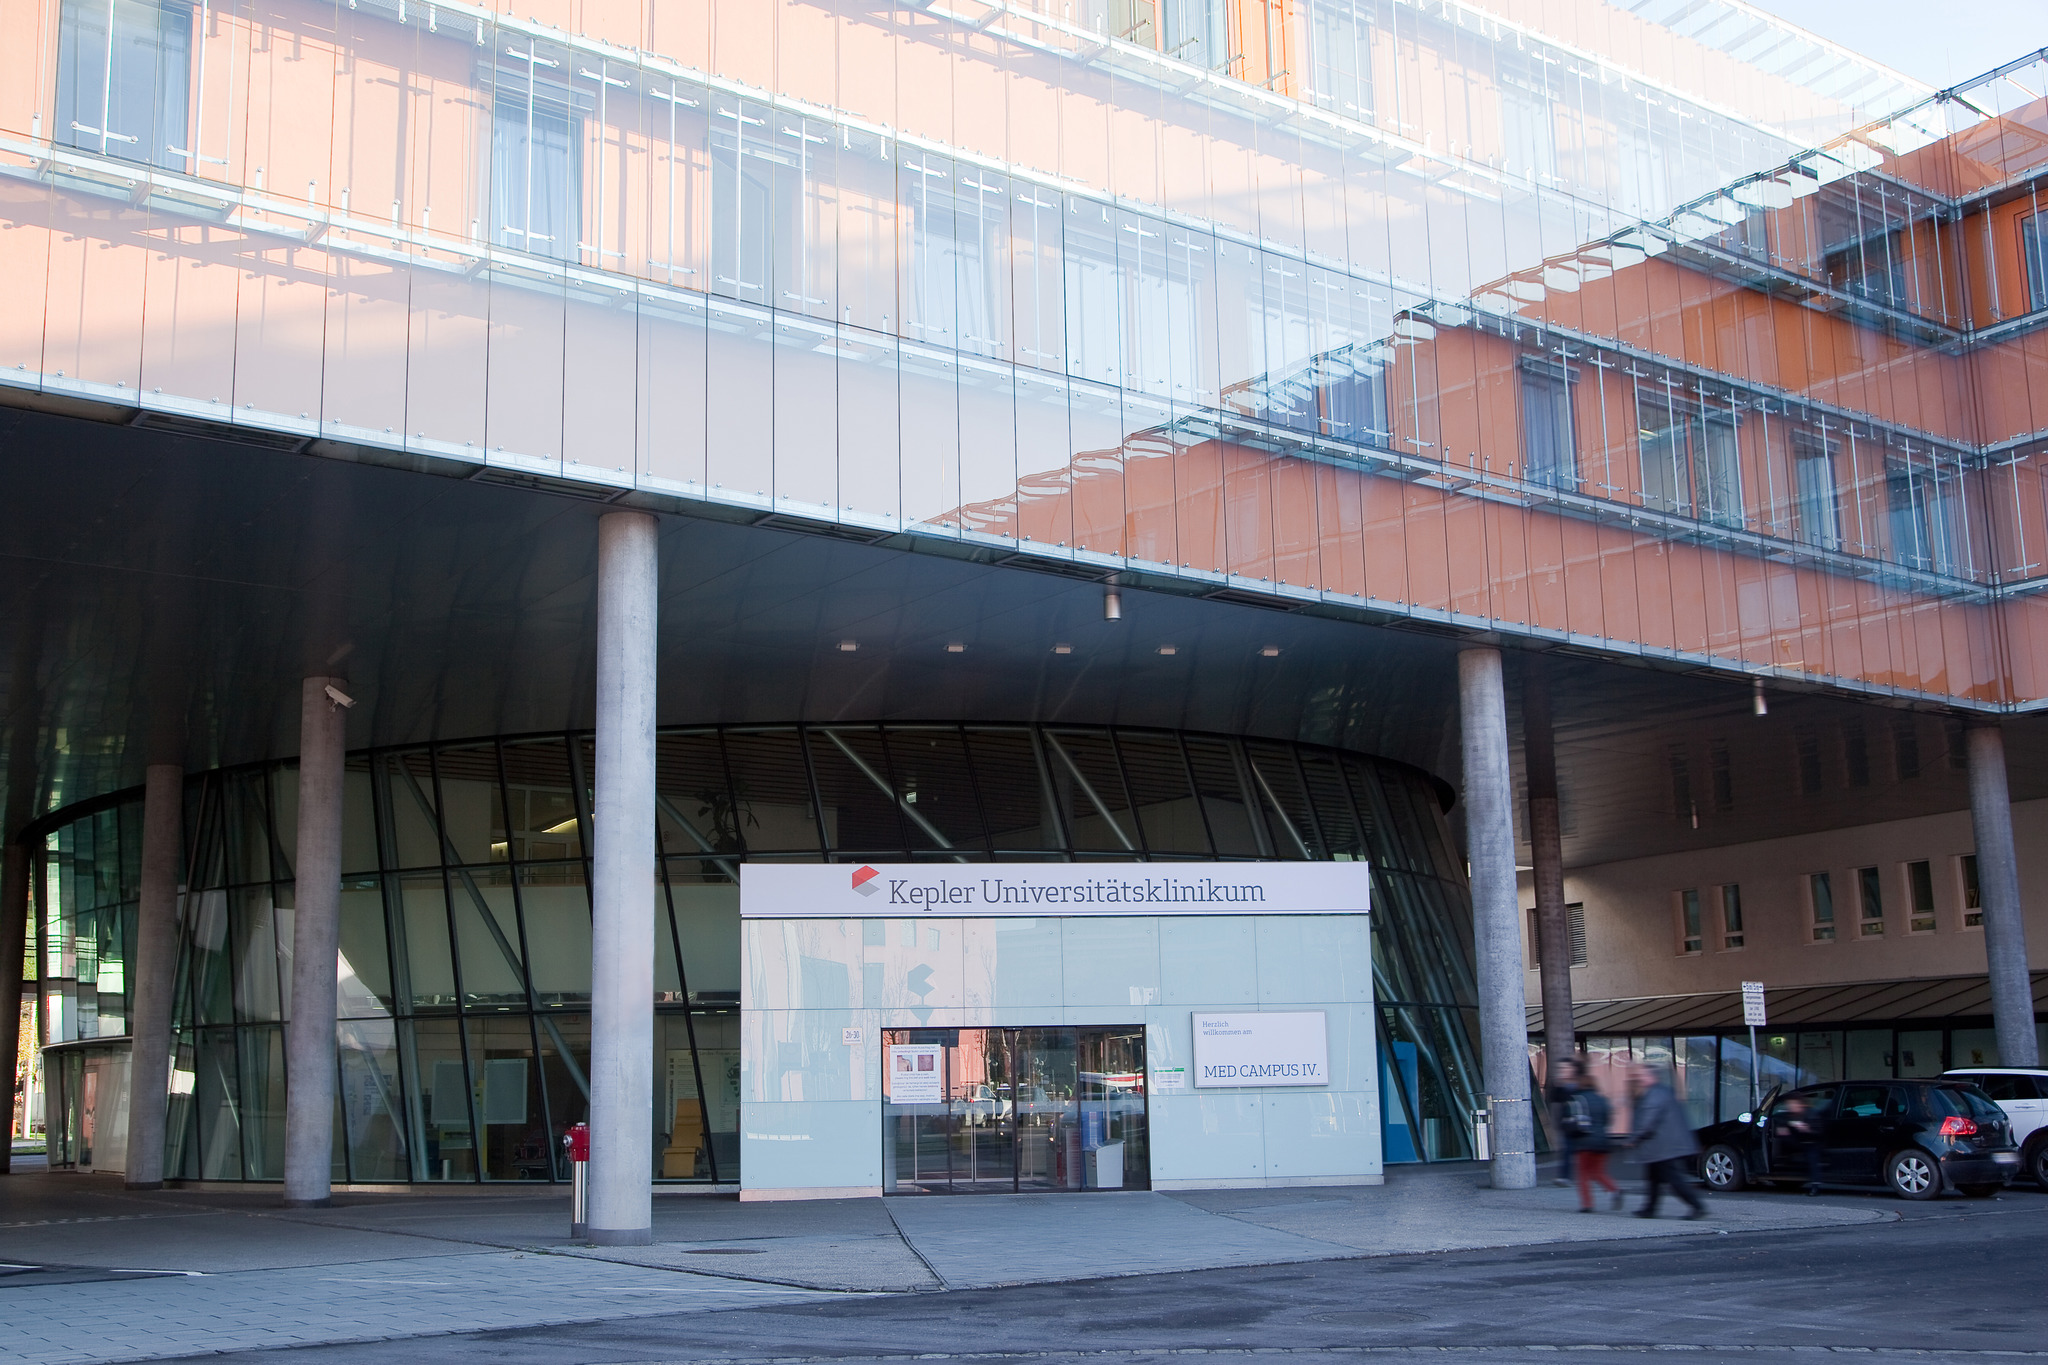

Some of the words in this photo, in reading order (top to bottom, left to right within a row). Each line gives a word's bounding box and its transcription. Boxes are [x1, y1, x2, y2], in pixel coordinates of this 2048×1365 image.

[888, 879, 976, 911] Kepler
[981, 877, 1266, 904] Universitätsklinikum
[1204, 1065, 1237, 1078] MED
[1239, 1064, 1299, 1077] CAMPUS
[1302, 1063, 1321, 1076] IV.
